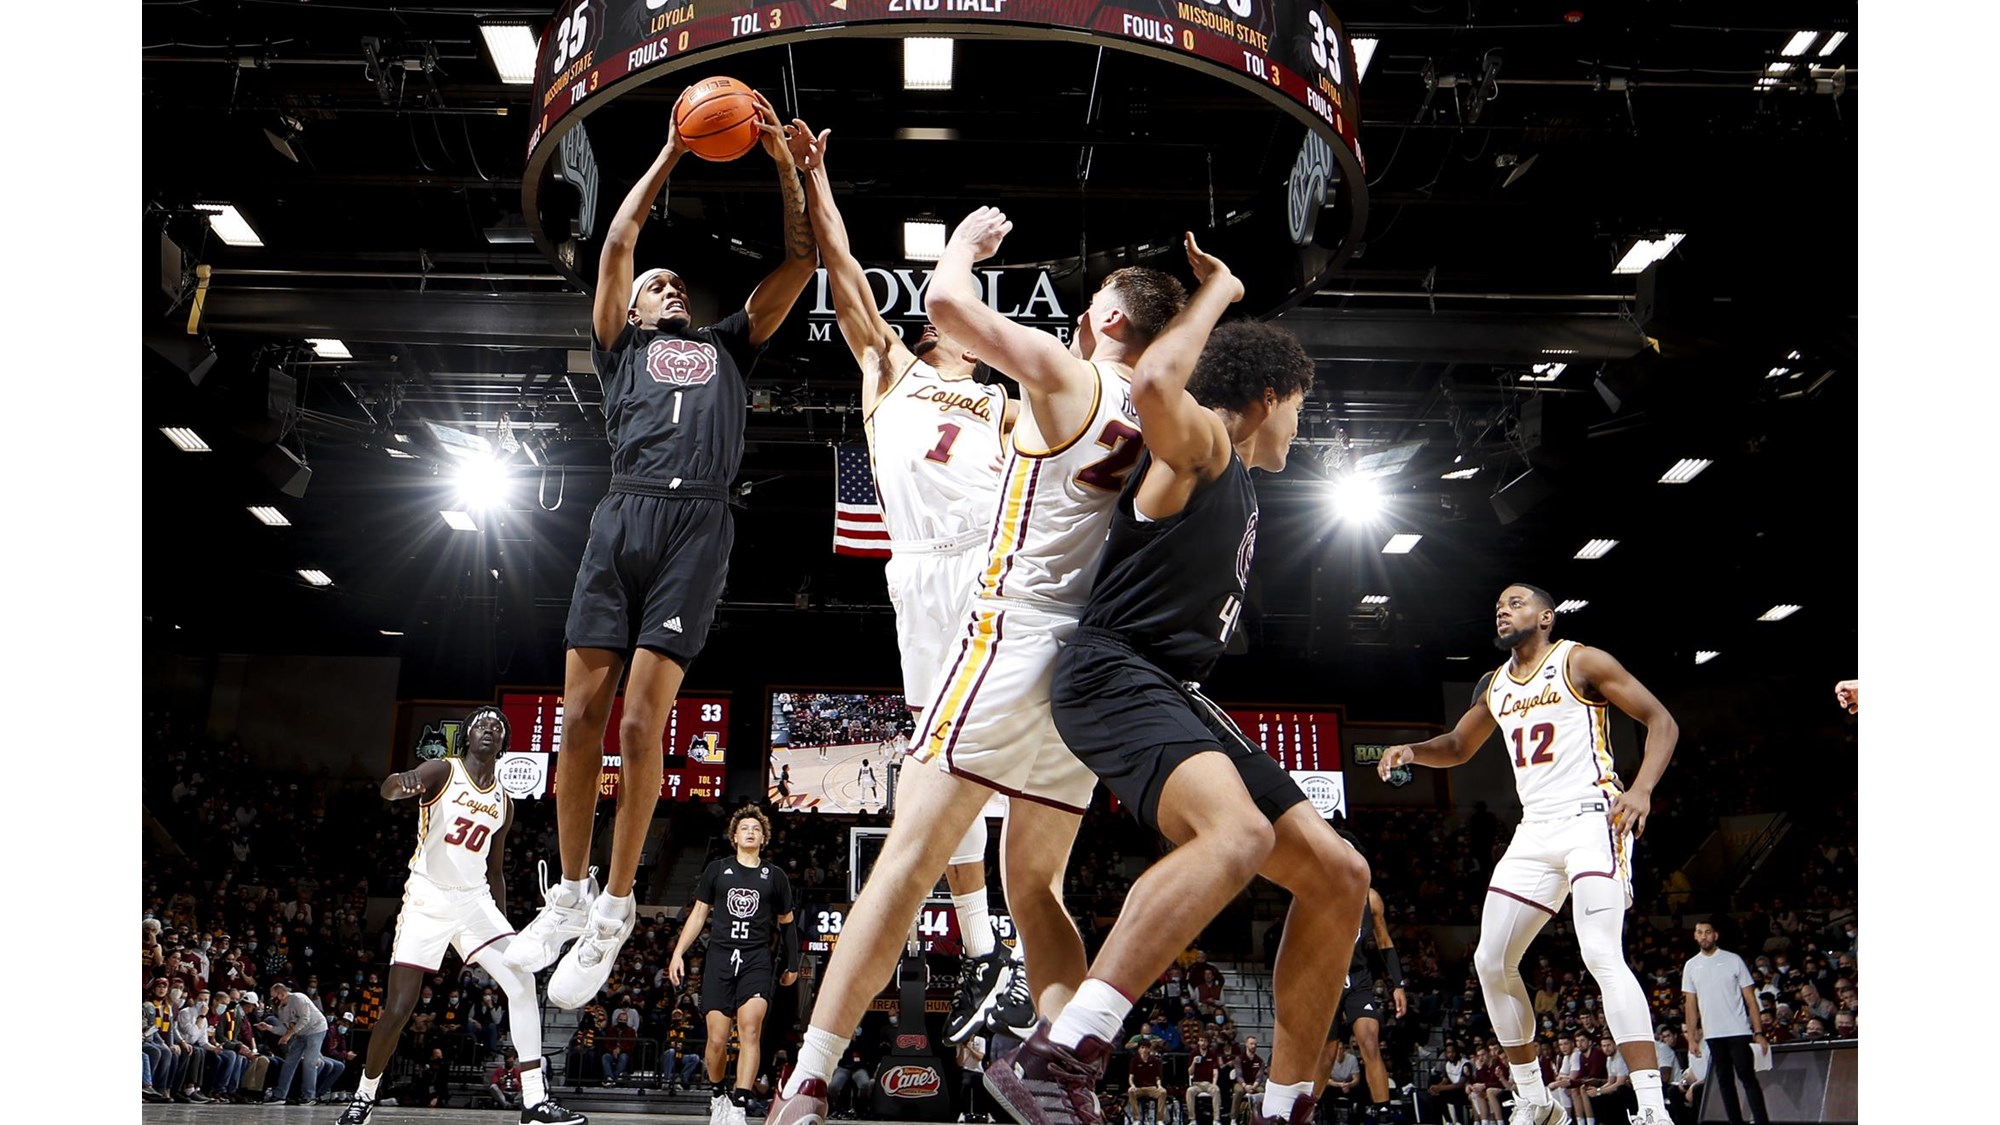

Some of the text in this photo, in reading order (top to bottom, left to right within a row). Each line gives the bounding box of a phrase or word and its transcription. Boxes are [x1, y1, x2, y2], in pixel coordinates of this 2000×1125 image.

[651, 4, 694, 34] LOYOLA
[731, 8, 782, 37] TOL 3
[1177, 2, 1235, 37] MISSOURI
[1237, 23, 1268, 53] STATE
[554, 0, 589, 75] 35
[1123, 13, 1195, 51] FOULS 0
[628, 31, 689, 72] FOULS 0
[1308, 9, 1341, 85] 33
[569, 50, 593, 80] STATE
[1243, 50, 1280, 86] TOL 3
[571, 70, 599, 105] TOL 3
[1306, 86, 1334, 124] FOULS
[672, 391, 684, 424] 1
[906, 385, 991, 422] Loyola
[925, 423, 961, 465] 1
[1073, 419, 1143, 491] 2
[538, 707, 542, 715] 1
[1498, 683, 1562, 718] Loyola
[535, 716, 542, 724] 4
[672, 709, 677, 718] 2
[701, 704, 722, 722] 33
[531, 734, 541, 743] 22
[533, 725, 542, 734] 12
[1277, 723, 1283, 732] 4
[1294, 724, 1299, 733] 1
[1311, 724, 1316, 733] 1
[1312, 734, 1317, 743] 1
[669, 747, 675, 755] 2
[670, 738, 675, 746] 1
[1278, 742, 1284, 751] 2
[1312, 743, 1317, 752] 1
[1511, 722, 1556, 769] 12
[1279, 752, 1284, 760] 1
[1313, 753, 1318, 761] 1
[1313, 762, 1318, 771] 1
[668, 775, 681, 786] 75
[671, 786, 677, 797] 1
[698, 775, 721, 785] TOL 3
[714, 789, 720, 797] 0
[452, 791, 499, 820] Loyola
[444, 816, 490, 852] 30
[731, 921, 750, 939] 25
[817, 910, 842, 933] 33
[808, 942, 828, 951] FOULS
